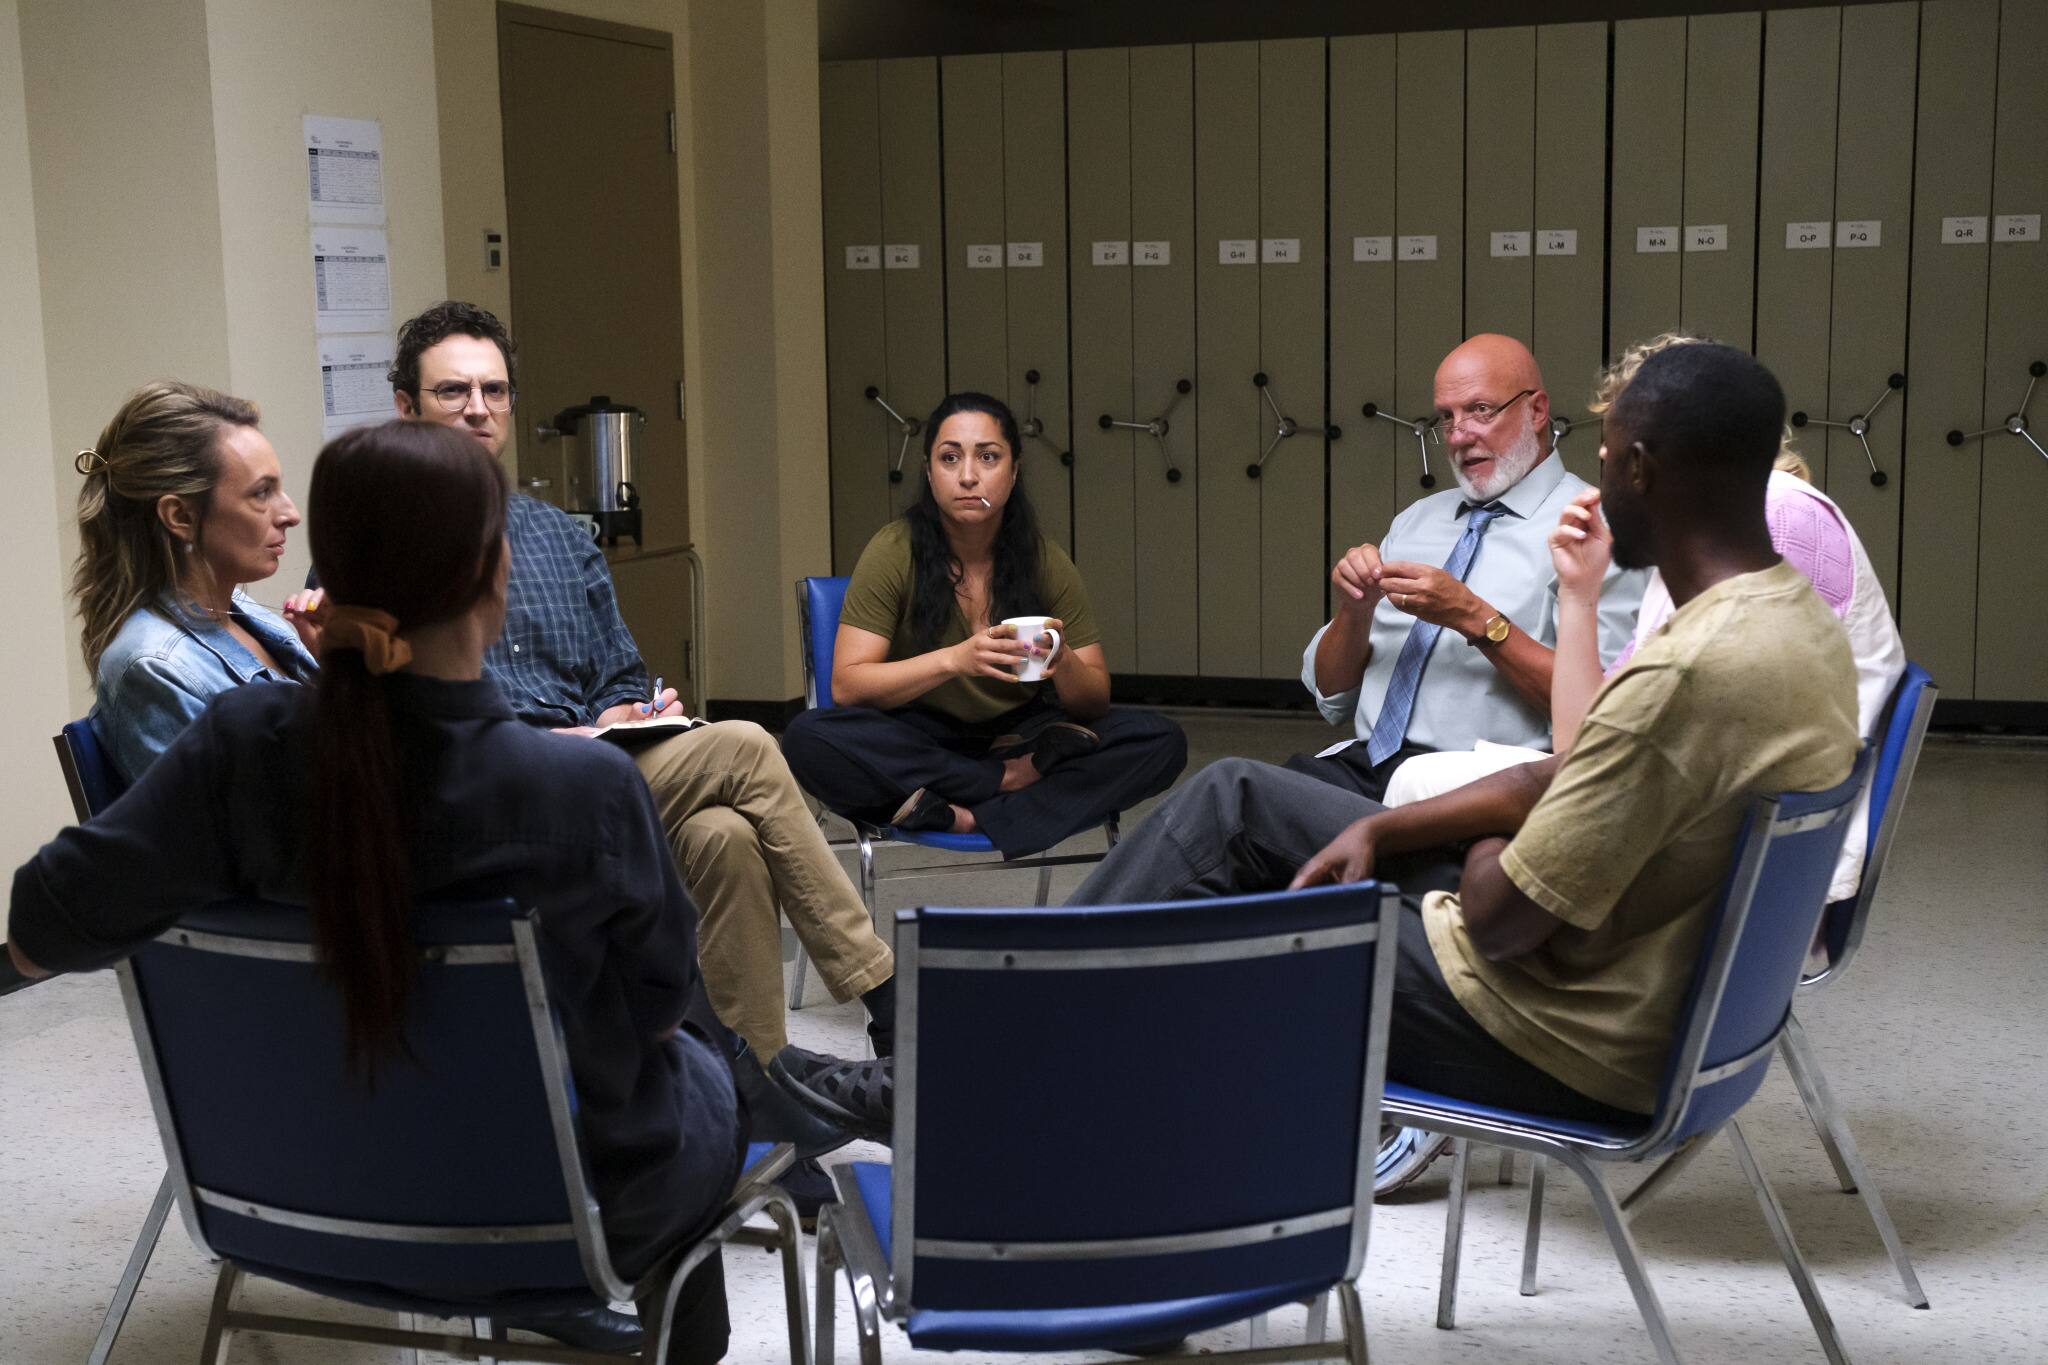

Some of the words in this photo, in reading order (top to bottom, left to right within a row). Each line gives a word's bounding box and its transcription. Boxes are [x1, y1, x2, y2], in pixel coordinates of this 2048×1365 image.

[1955, 229, 1973, 238] Q-R
[2008, 227, 2026, 236] R-S
[1698, 237, 1715, 245] N-O
[1800, 234, 1817, 242] O-P
[1850, 233, 1867, 241] P-Q
[1549, 241, 1564, 249] L-M
[1649, 238, 1666, 246] M-N
[1410, 247, 1424, 255] J-K
[1503, 243, 1518, 251] K-L
[1104, 252, 1116, 260] E-F
[1145, 252, 1159, 260] F-G
[1230, 251, 1245, 259] G-H
[1368, 248, 1378, 256] I-J
[895, 255, 908, 263] B-C
